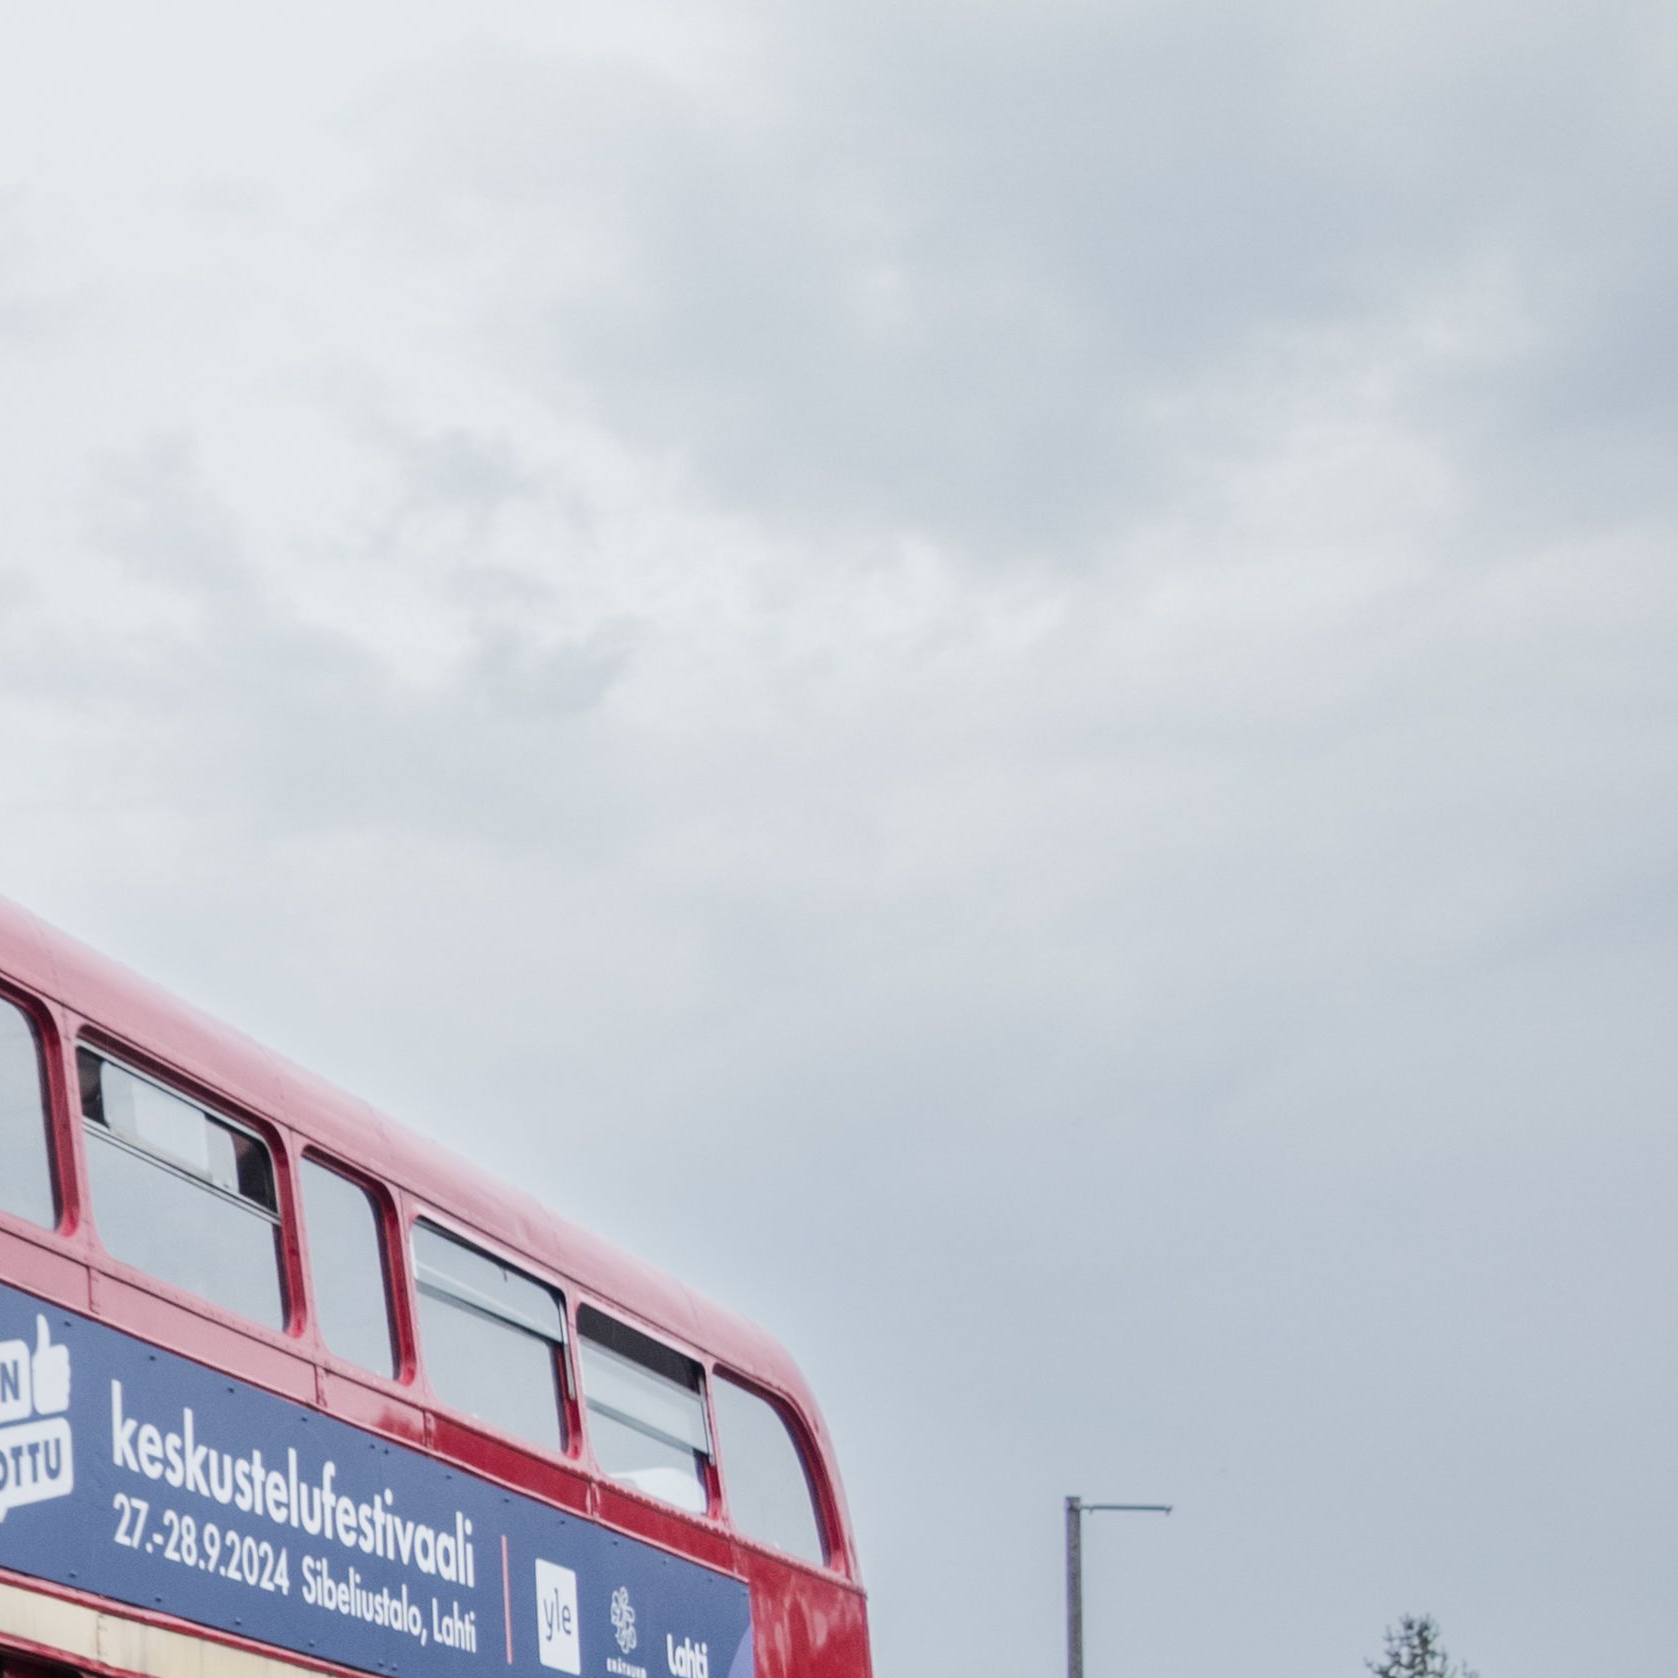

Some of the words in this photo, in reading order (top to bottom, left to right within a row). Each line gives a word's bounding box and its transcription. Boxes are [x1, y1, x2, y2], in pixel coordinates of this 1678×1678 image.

[111, 1378, 475, 1589] keskustelufestivaali
[113, 1492, 290, 1596] 27.-28.9.2024
[302, 1555, 428, 1647] Sibeliustalo,
[432, 1597, 477, 1653] Lahti
[544, 1587, 572, 1642] yle
